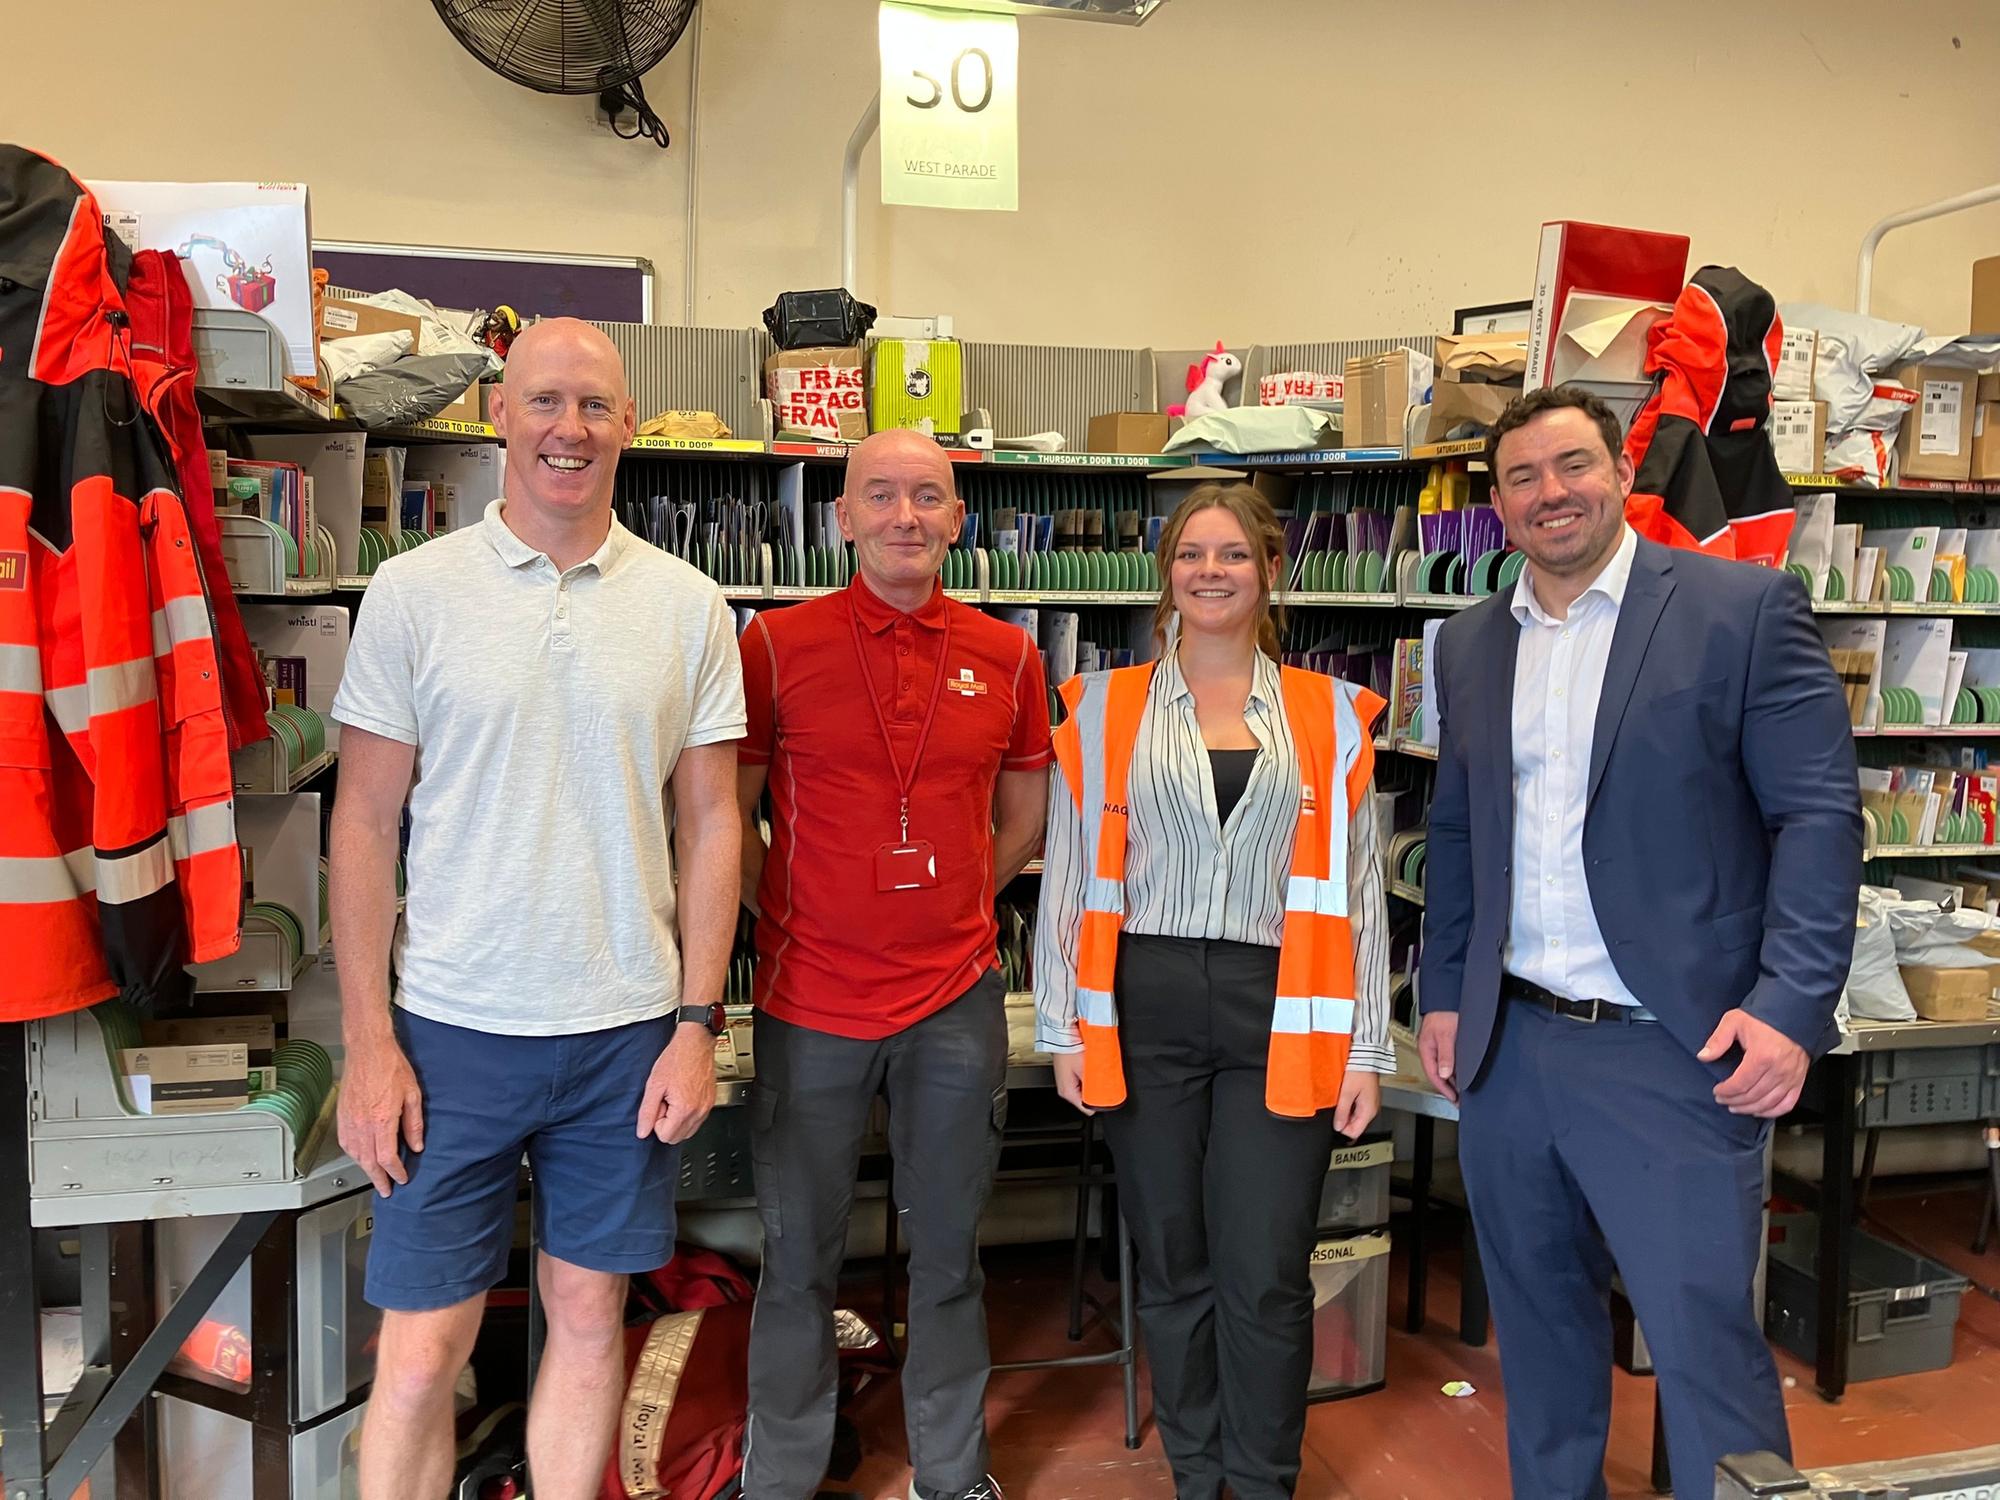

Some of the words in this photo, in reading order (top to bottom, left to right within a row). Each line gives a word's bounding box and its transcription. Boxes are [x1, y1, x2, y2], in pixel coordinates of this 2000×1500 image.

[904, 159, 941, 175] WEST
[943, 163, 997, 177] PARADE
[1535, 307, 1544, 337] WEST
[1530, 340, 1540, 380] PARADE
[428, 420, 450, 431] DOOR
[452, 422, 462, 431] TO
[464, 424, 485, 435] DOOR
[646, 438, 671, 448] DOOR
[675, 440, 686, 448] TO
[1467, 441, 1482, 451] DOOR
[1038, 454, 1087, 464] THURSDAY'S
[1089, 456, 1112, 465] DOOR
[1114, 456, 1125, 465] TO
[1127, 457, 1150, 466] DOOR
[1246, 454, 1281, 464] FRIDAY'S
[1283, 453, 1307, 462] DOOR
[1310, 453, 1320, 461] TO
[1322, 452, 1346, 461] DOOR
[288, 615, 317, 627] whistl
[950, 680, 969, 690] Royal
[970, 681, 985, 691] Mail
[1334, 1148, 1371, 1165] BANDS
[633, 1403, 658, 1450] Royal
